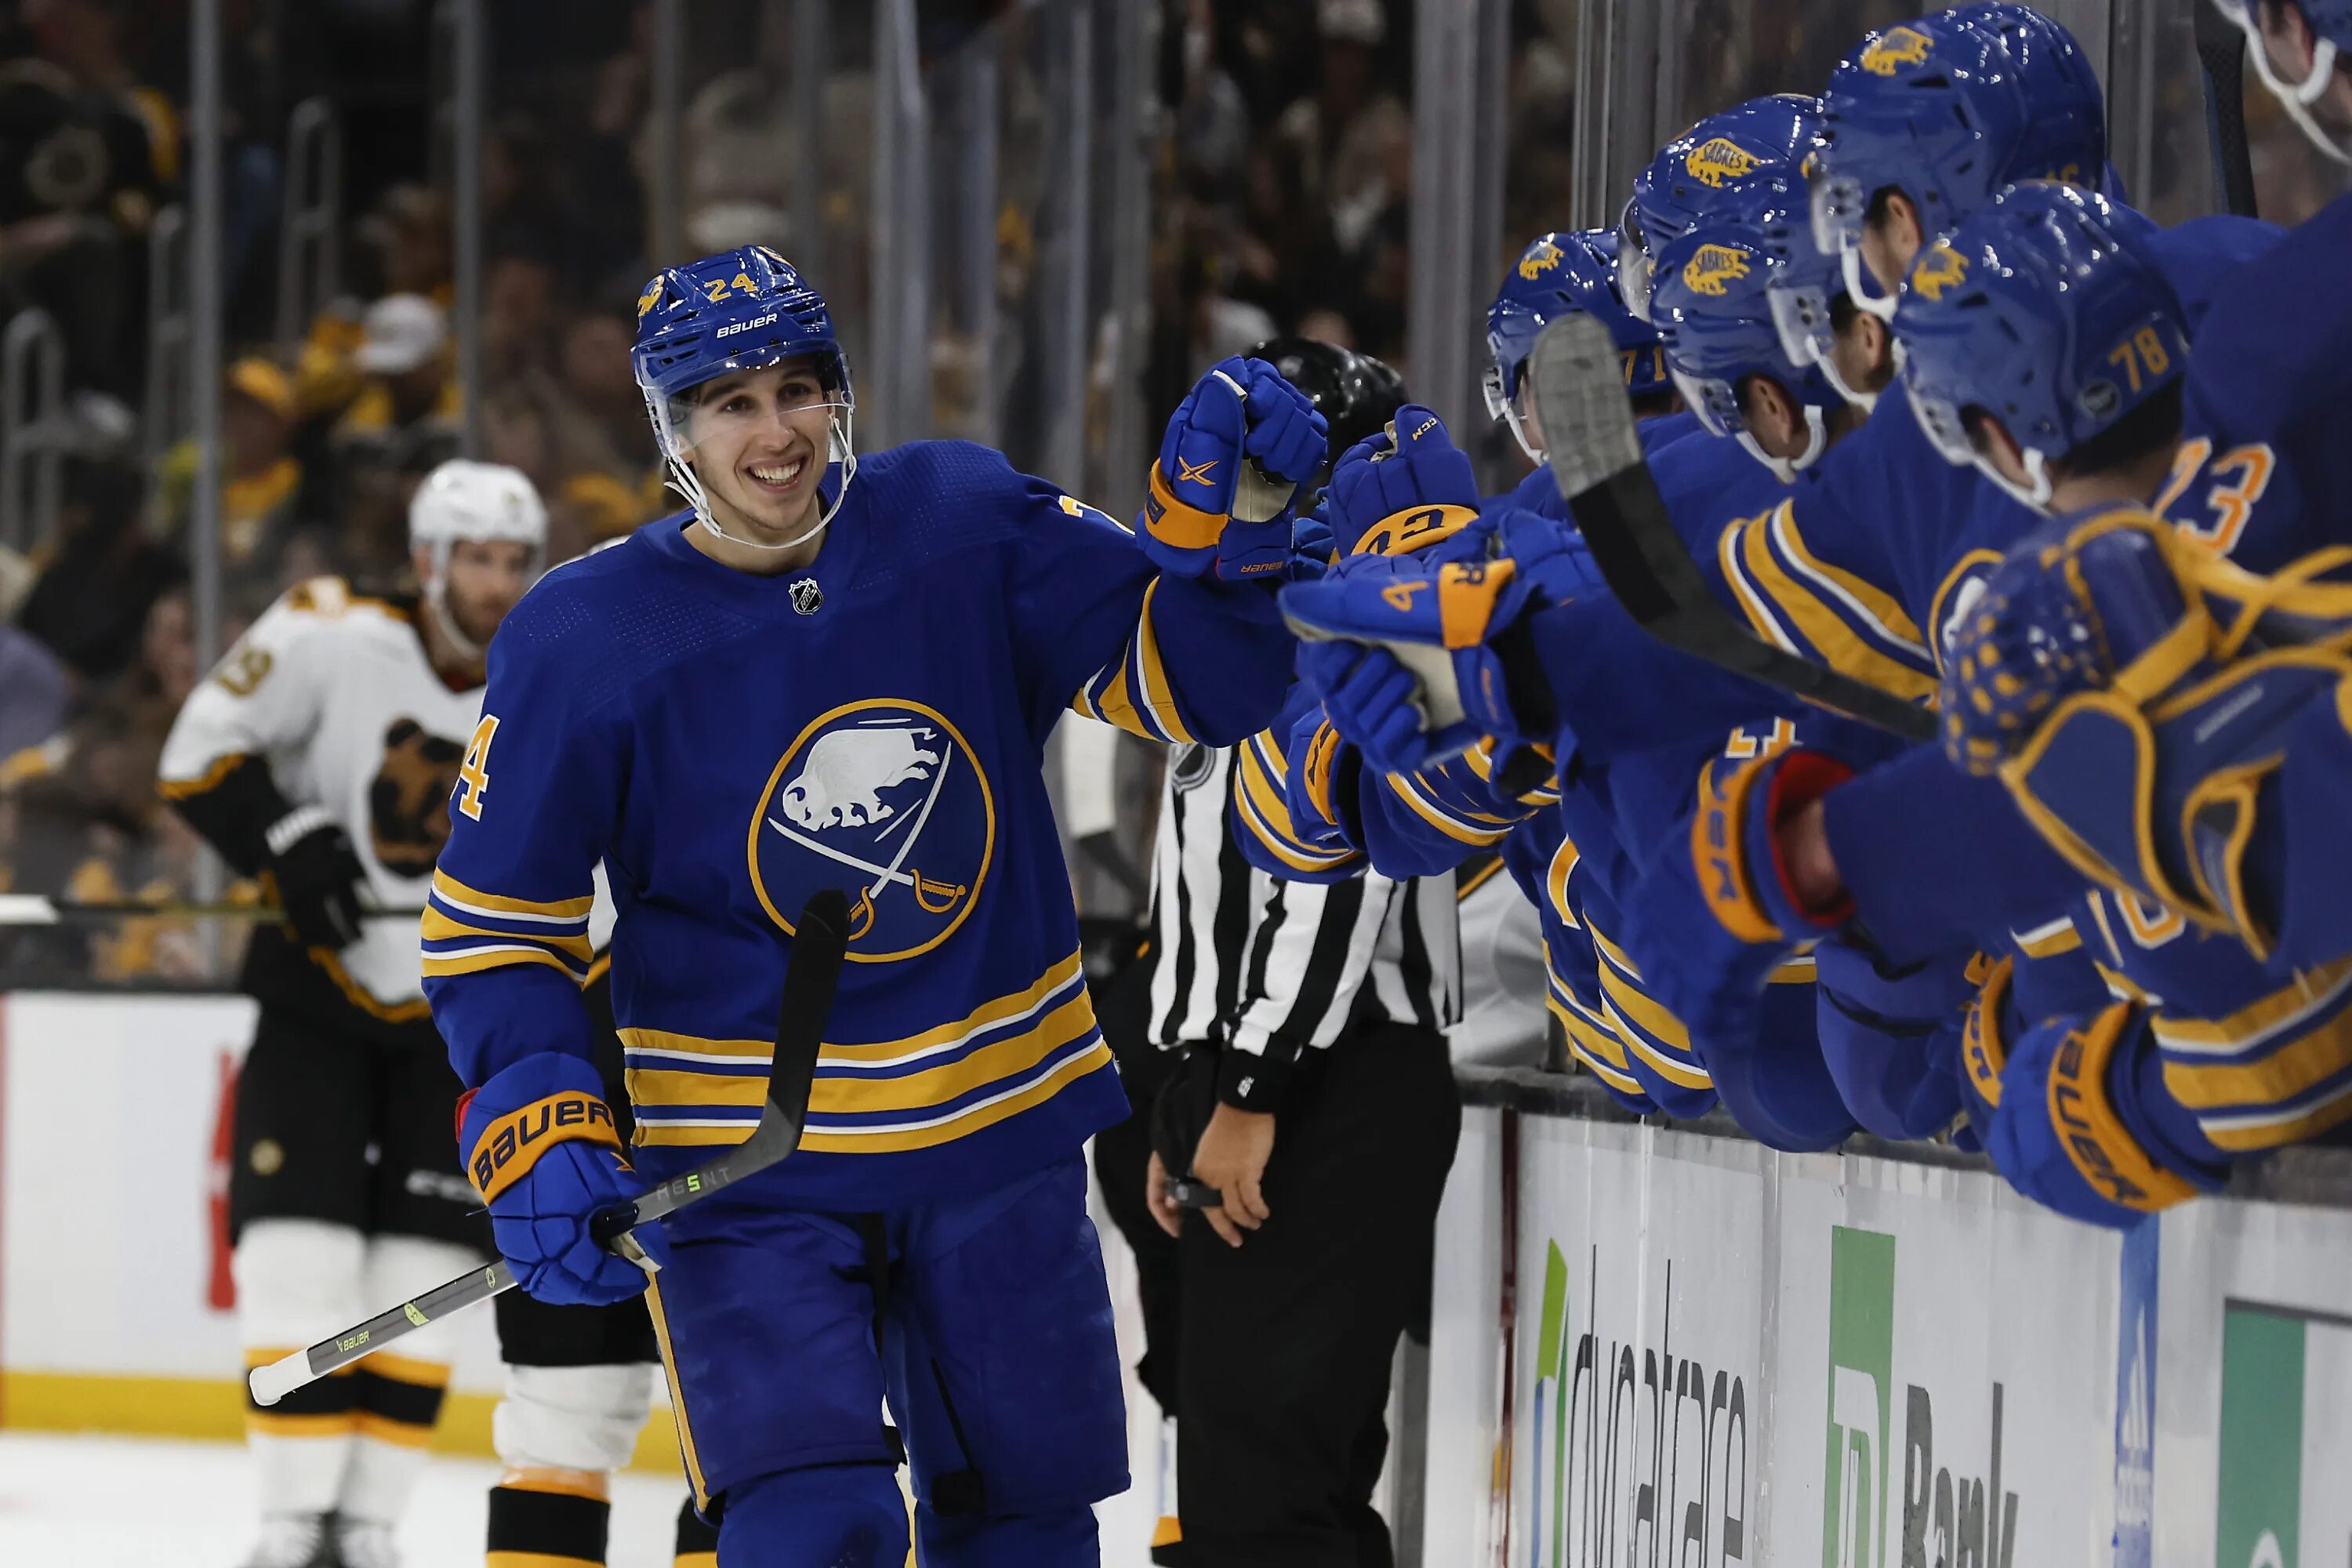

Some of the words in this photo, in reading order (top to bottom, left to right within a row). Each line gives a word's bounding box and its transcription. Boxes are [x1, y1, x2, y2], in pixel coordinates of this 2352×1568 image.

[705, 273, 758, 302] 24
[716, 313, 778, 339] BAUER
[1619, 347, 1667, 386] 71
[2107, 325, 2169, 393] 78
[1411, 417, 1438, 441] CCM
[449, 713, 501, 822] 4
[474, 1100, 613, 1192] BAUER
[343, 1330, 370, 1352] BAUER
